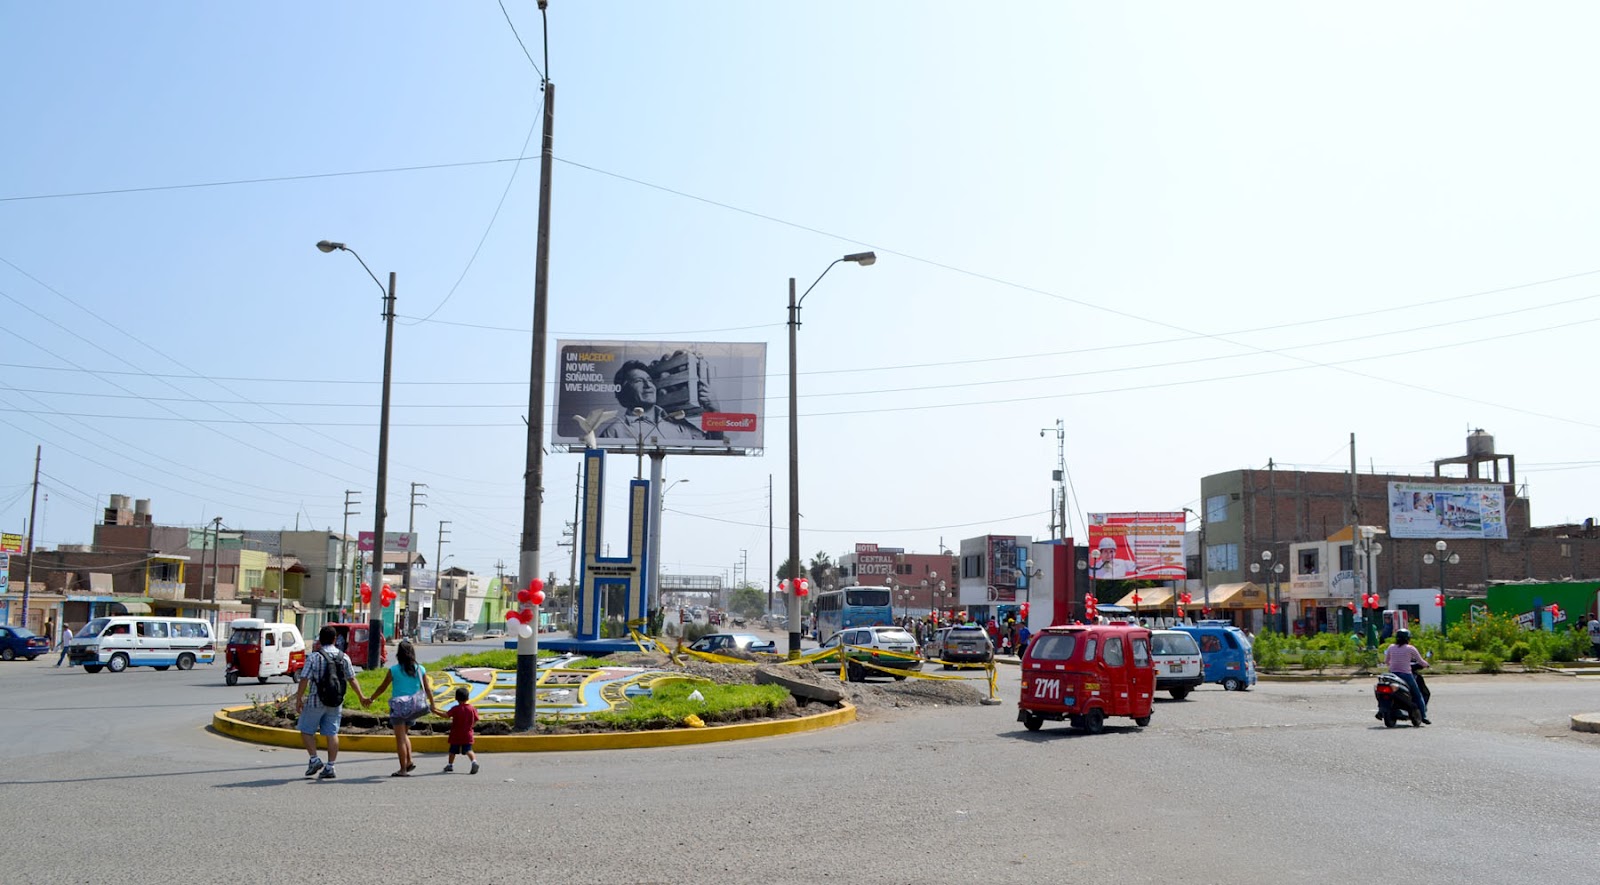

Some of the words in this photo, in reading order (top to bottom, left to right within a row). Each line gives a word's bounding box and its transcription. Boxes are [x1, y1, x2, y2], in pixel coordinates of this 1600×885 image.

[566, 353, 578, 361] UN
[579, 353, 614, 361] HACEDOR
[565, 363, 578, 371] NO
[578, 363, 595, 371] VIVE
[565, 372, 604, 383] SOÑANDO,
[565, 383, 582, 391] VIVE
[583, 384, 621, 392] HACIENDO
[857, 544, 877, 552] HOTEL
[860, 555, 893, 563] CENTRAL
[858, 564, 896, 575] HOTEL
[1034, 678, 1060, 699] 2711
